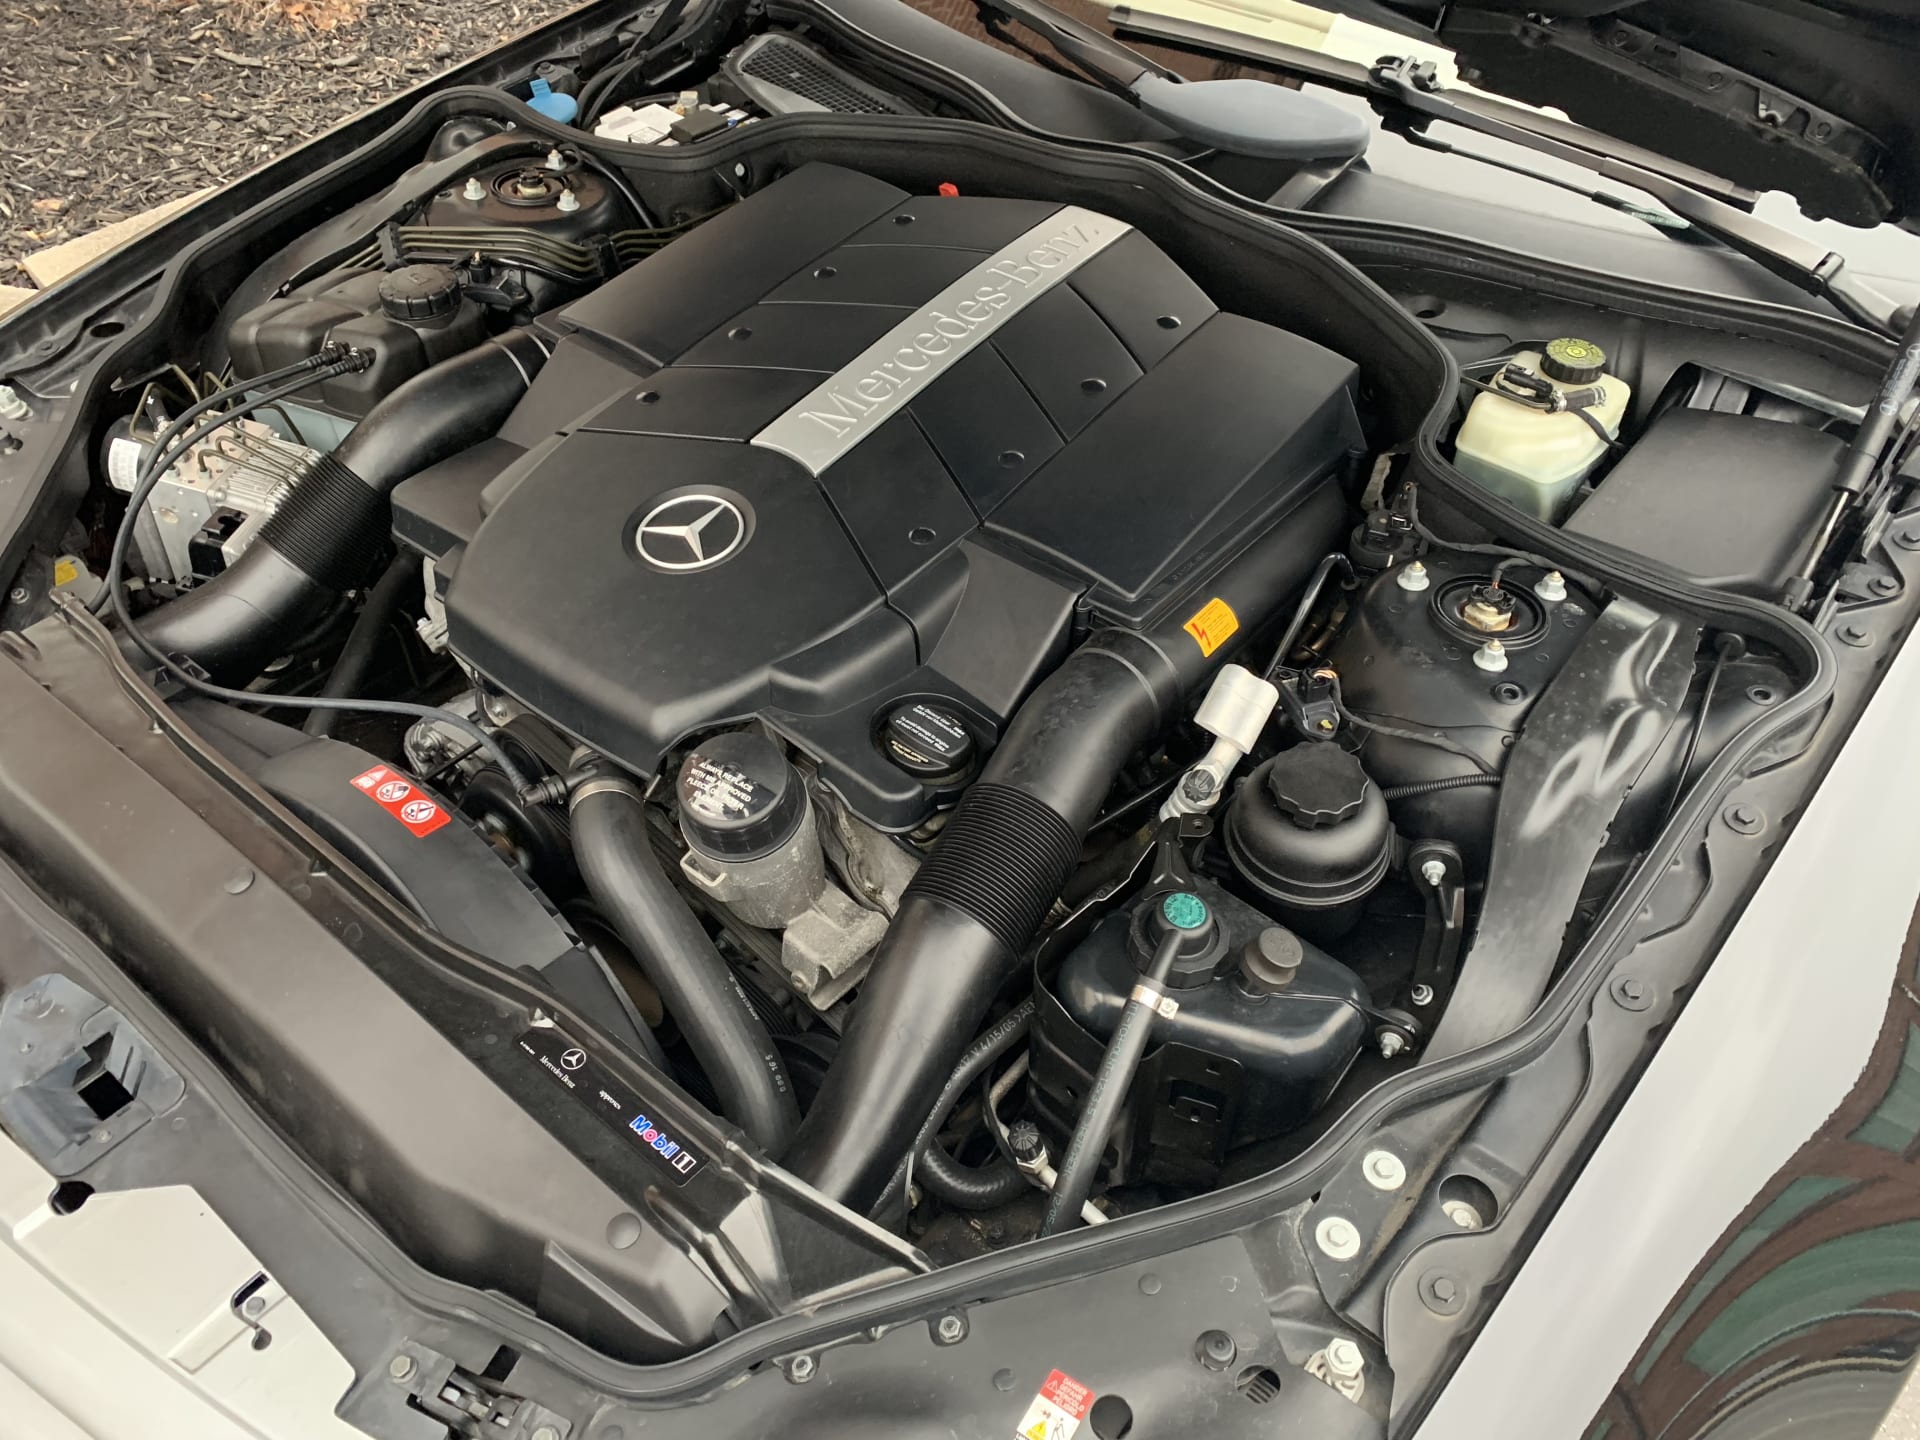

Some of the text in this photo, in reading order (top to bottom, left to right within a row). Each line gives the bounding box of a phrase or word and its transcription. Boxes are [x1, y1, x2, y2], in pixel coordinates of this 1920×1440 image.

[798, 223, 1100, 438] Mercedes-Benz
[691, 768, 705, 779] WITH
[699, 762, 753, 792] ALWAYS REPLACE
[981, 1019, 1016, 1051] 4/15/05
[629, 1114, 680, 1159] Mobil
